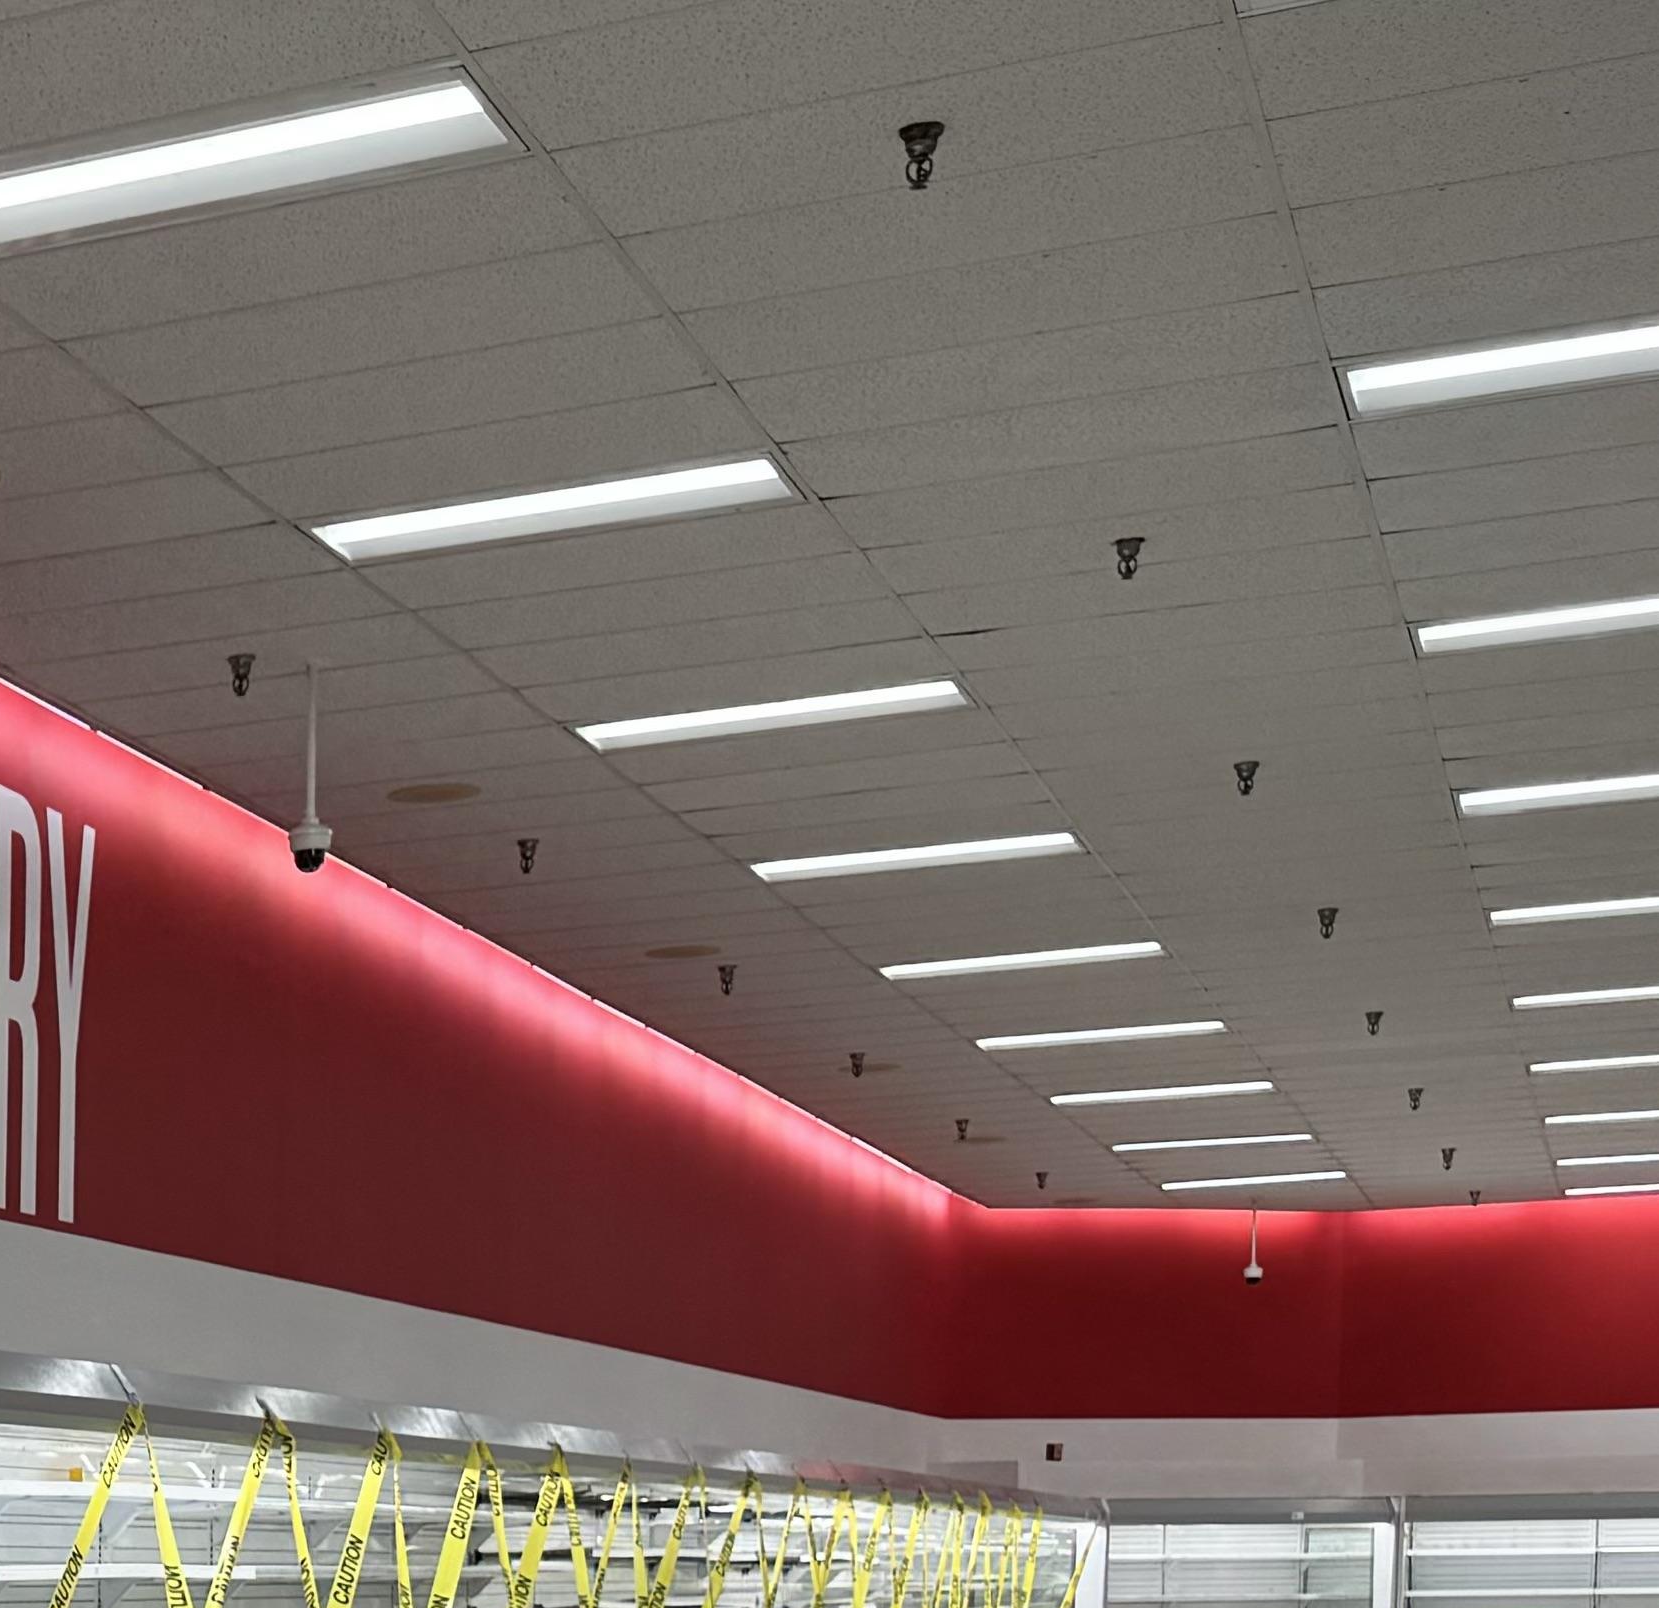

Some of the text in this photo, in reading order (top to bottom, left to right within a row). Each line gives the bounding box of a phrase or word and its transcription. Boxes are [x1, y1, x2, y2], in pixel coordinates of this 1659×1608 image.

[101, 1412, 137, 1490] CAUTION
[451, 1477, 477, 1540] CAUTION
[535, 1469, 561, 1527] CAUTION
[333, 1534, 364, 1605] CAUTION
